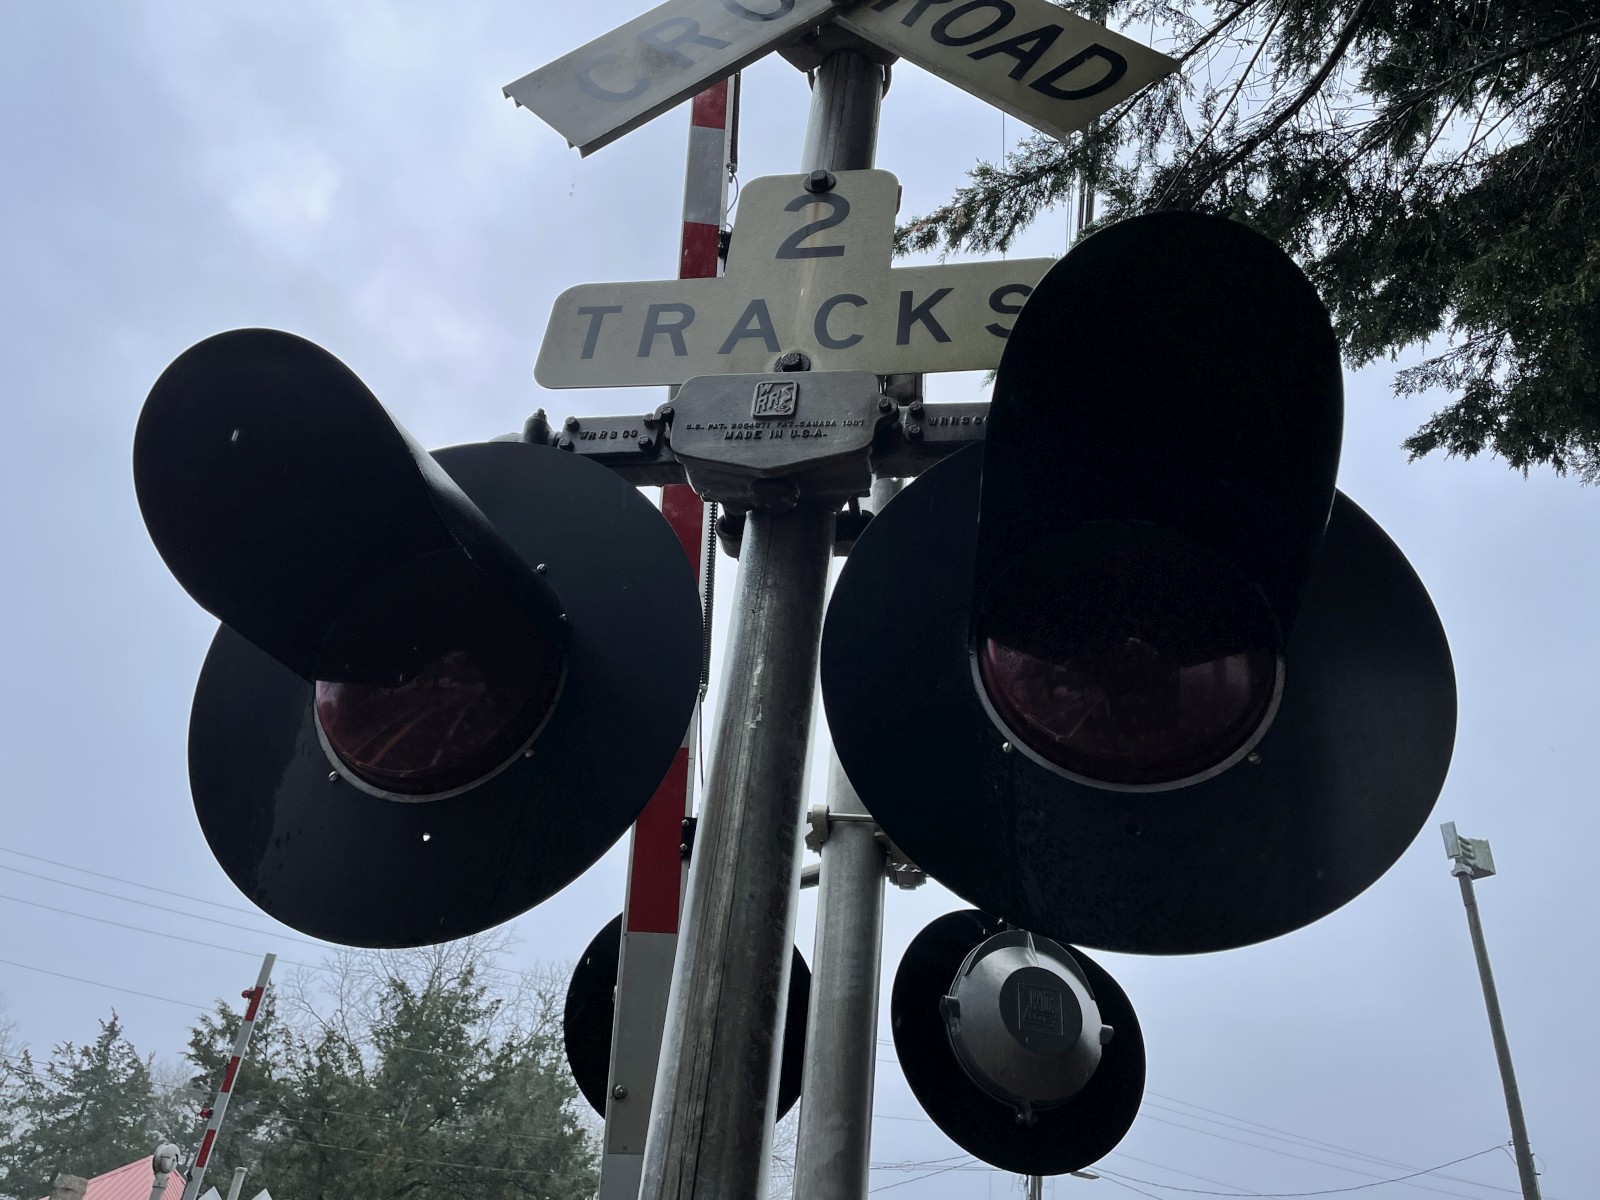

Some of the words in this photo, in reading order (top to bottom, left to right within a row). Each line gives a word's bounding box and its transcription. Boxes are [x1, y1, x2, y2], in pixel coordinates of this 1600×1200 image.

[775, 192, 851, 260] 2
[576, 283, 1034, 361] TRACKS
[724, 430, 763, 441] MADE
[769, 429, 783, 439] IN
[790, 427, 828, 438] U.S.A.
